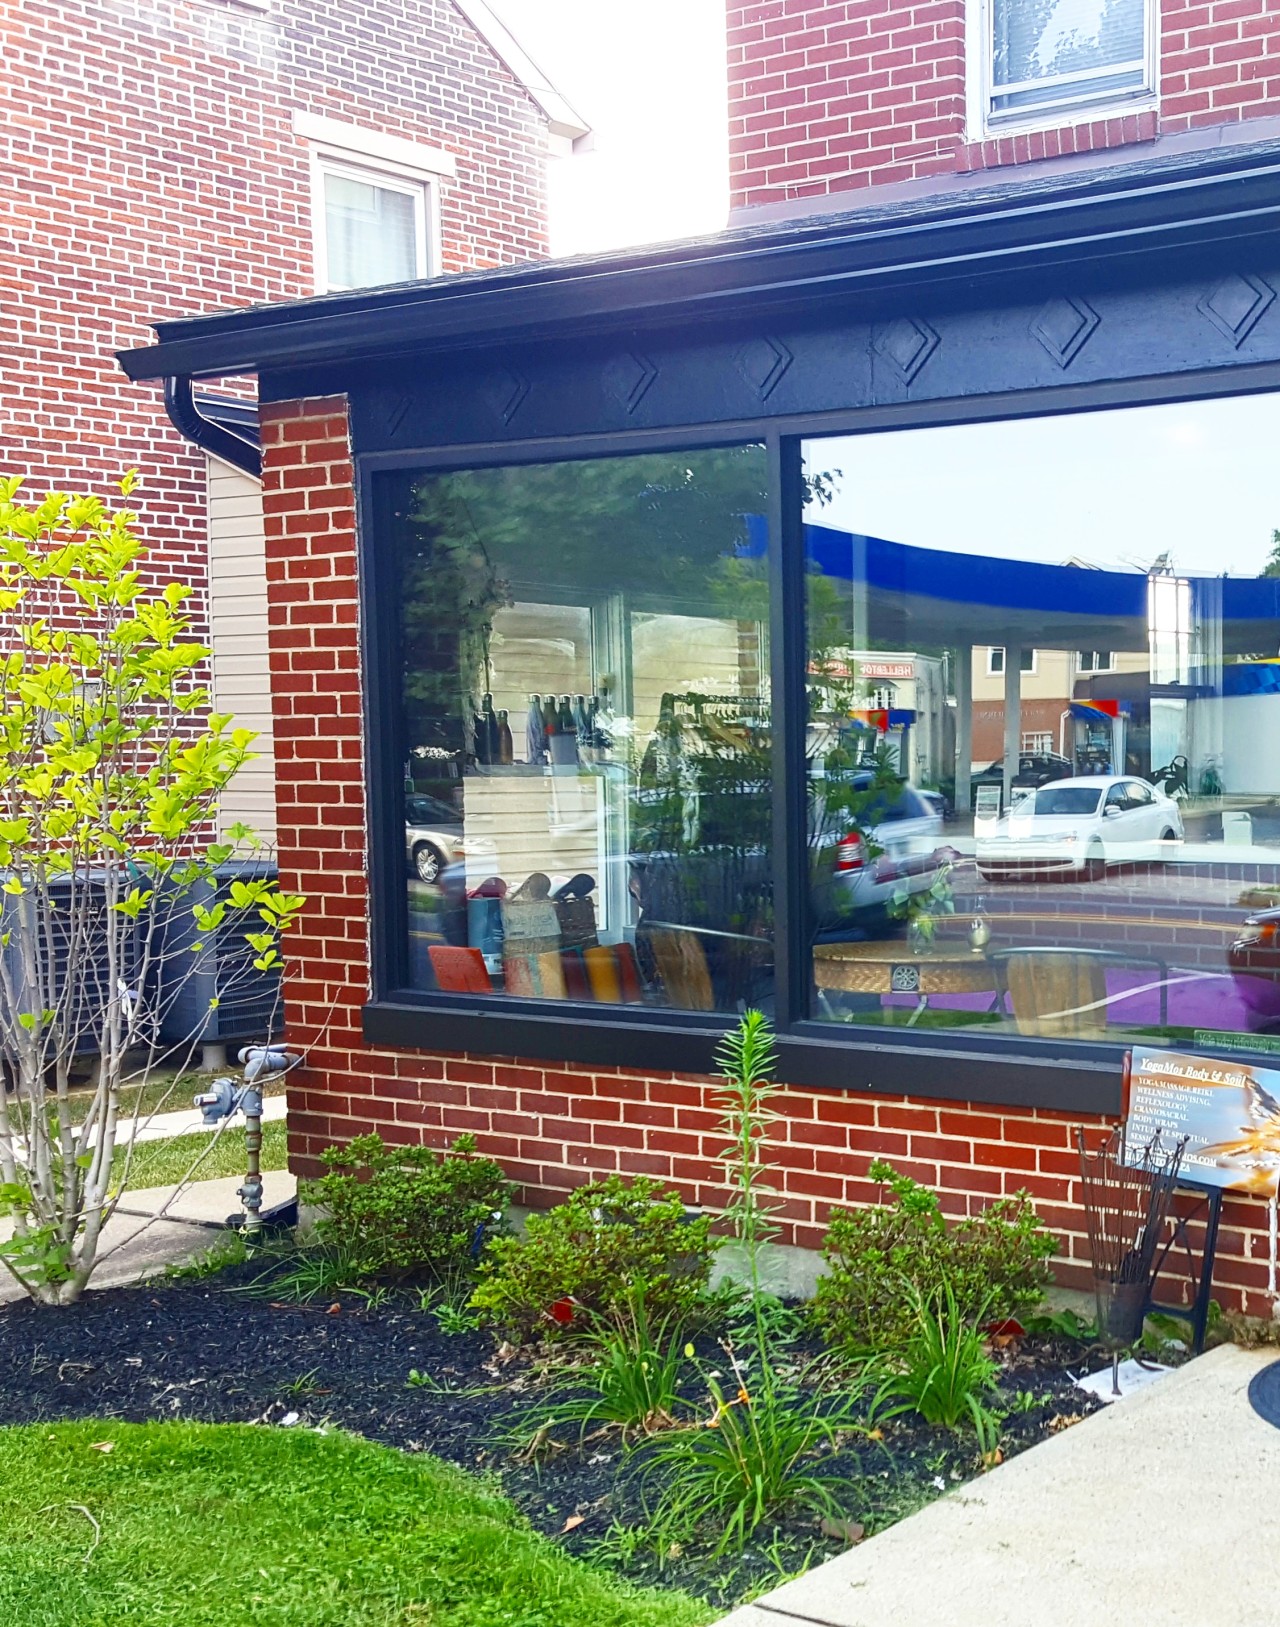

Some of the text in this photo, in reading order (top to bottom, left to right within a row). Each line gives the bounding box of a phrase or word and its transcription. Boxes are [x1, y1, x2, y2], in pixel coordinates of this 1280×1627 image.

[1140, 1058, 1247, 1087] YogaMos Body & Soul
[1137, 1086, 1174, 1099] WELLNESS
[1133, 1114, 1178, 1129] BODY WRAPS
